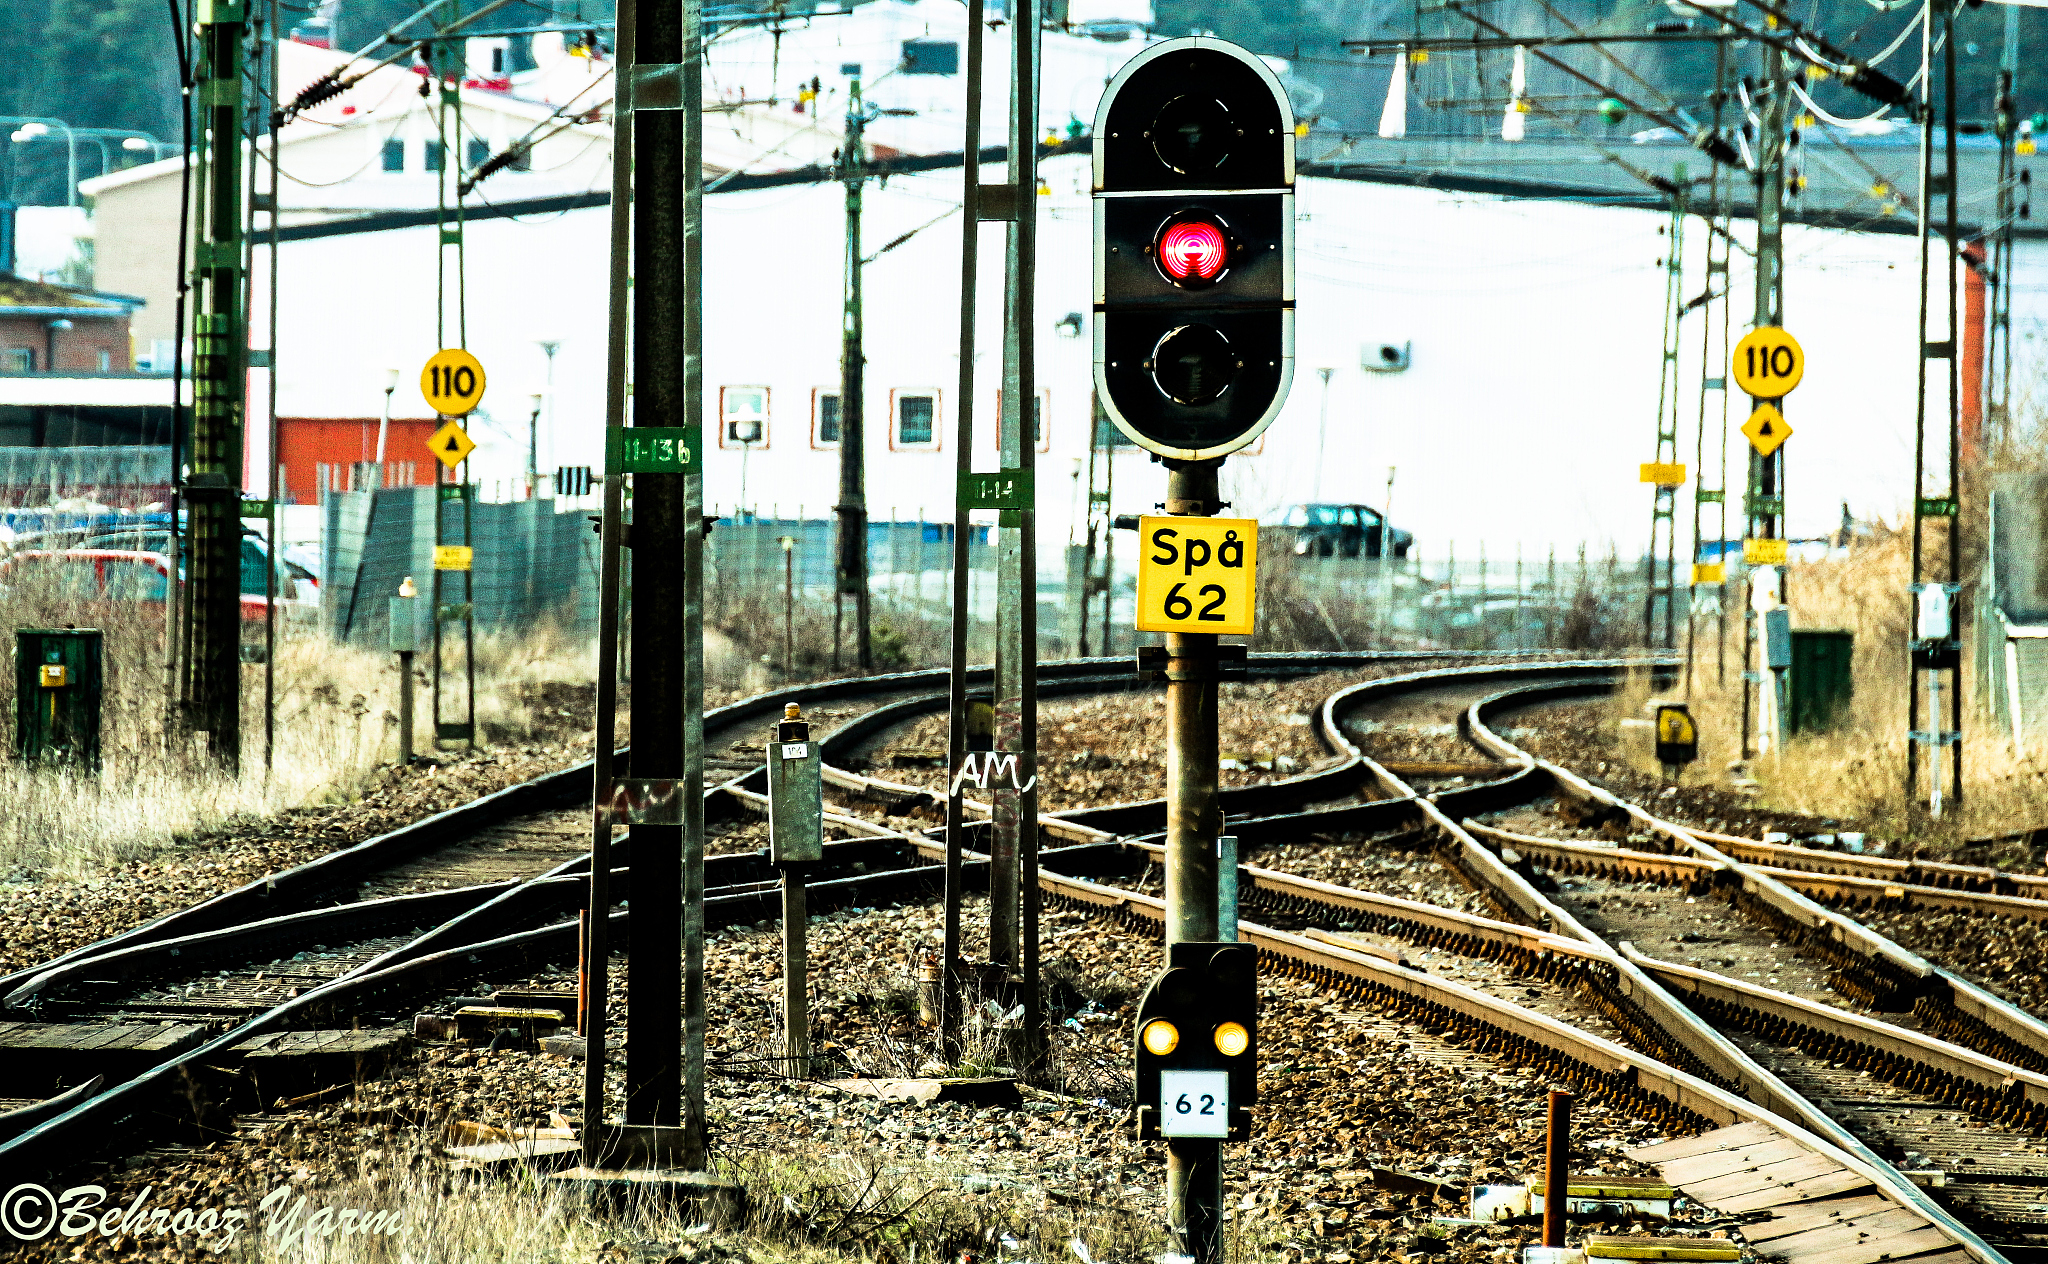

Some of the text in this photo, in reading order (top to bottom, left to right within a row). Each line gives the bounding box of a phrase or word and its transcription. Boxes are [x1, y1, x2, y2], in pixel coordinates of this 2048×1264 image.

[1745, 345, 1795, 378] 110
[430, 365, 476, 398] 110
[1151, 528, 1244, 576] Spå
[1163, 582, 1227, 622] 62
[950, 752, 1037, 797] AM
[1175, 1093, 1215, 1116] 62
